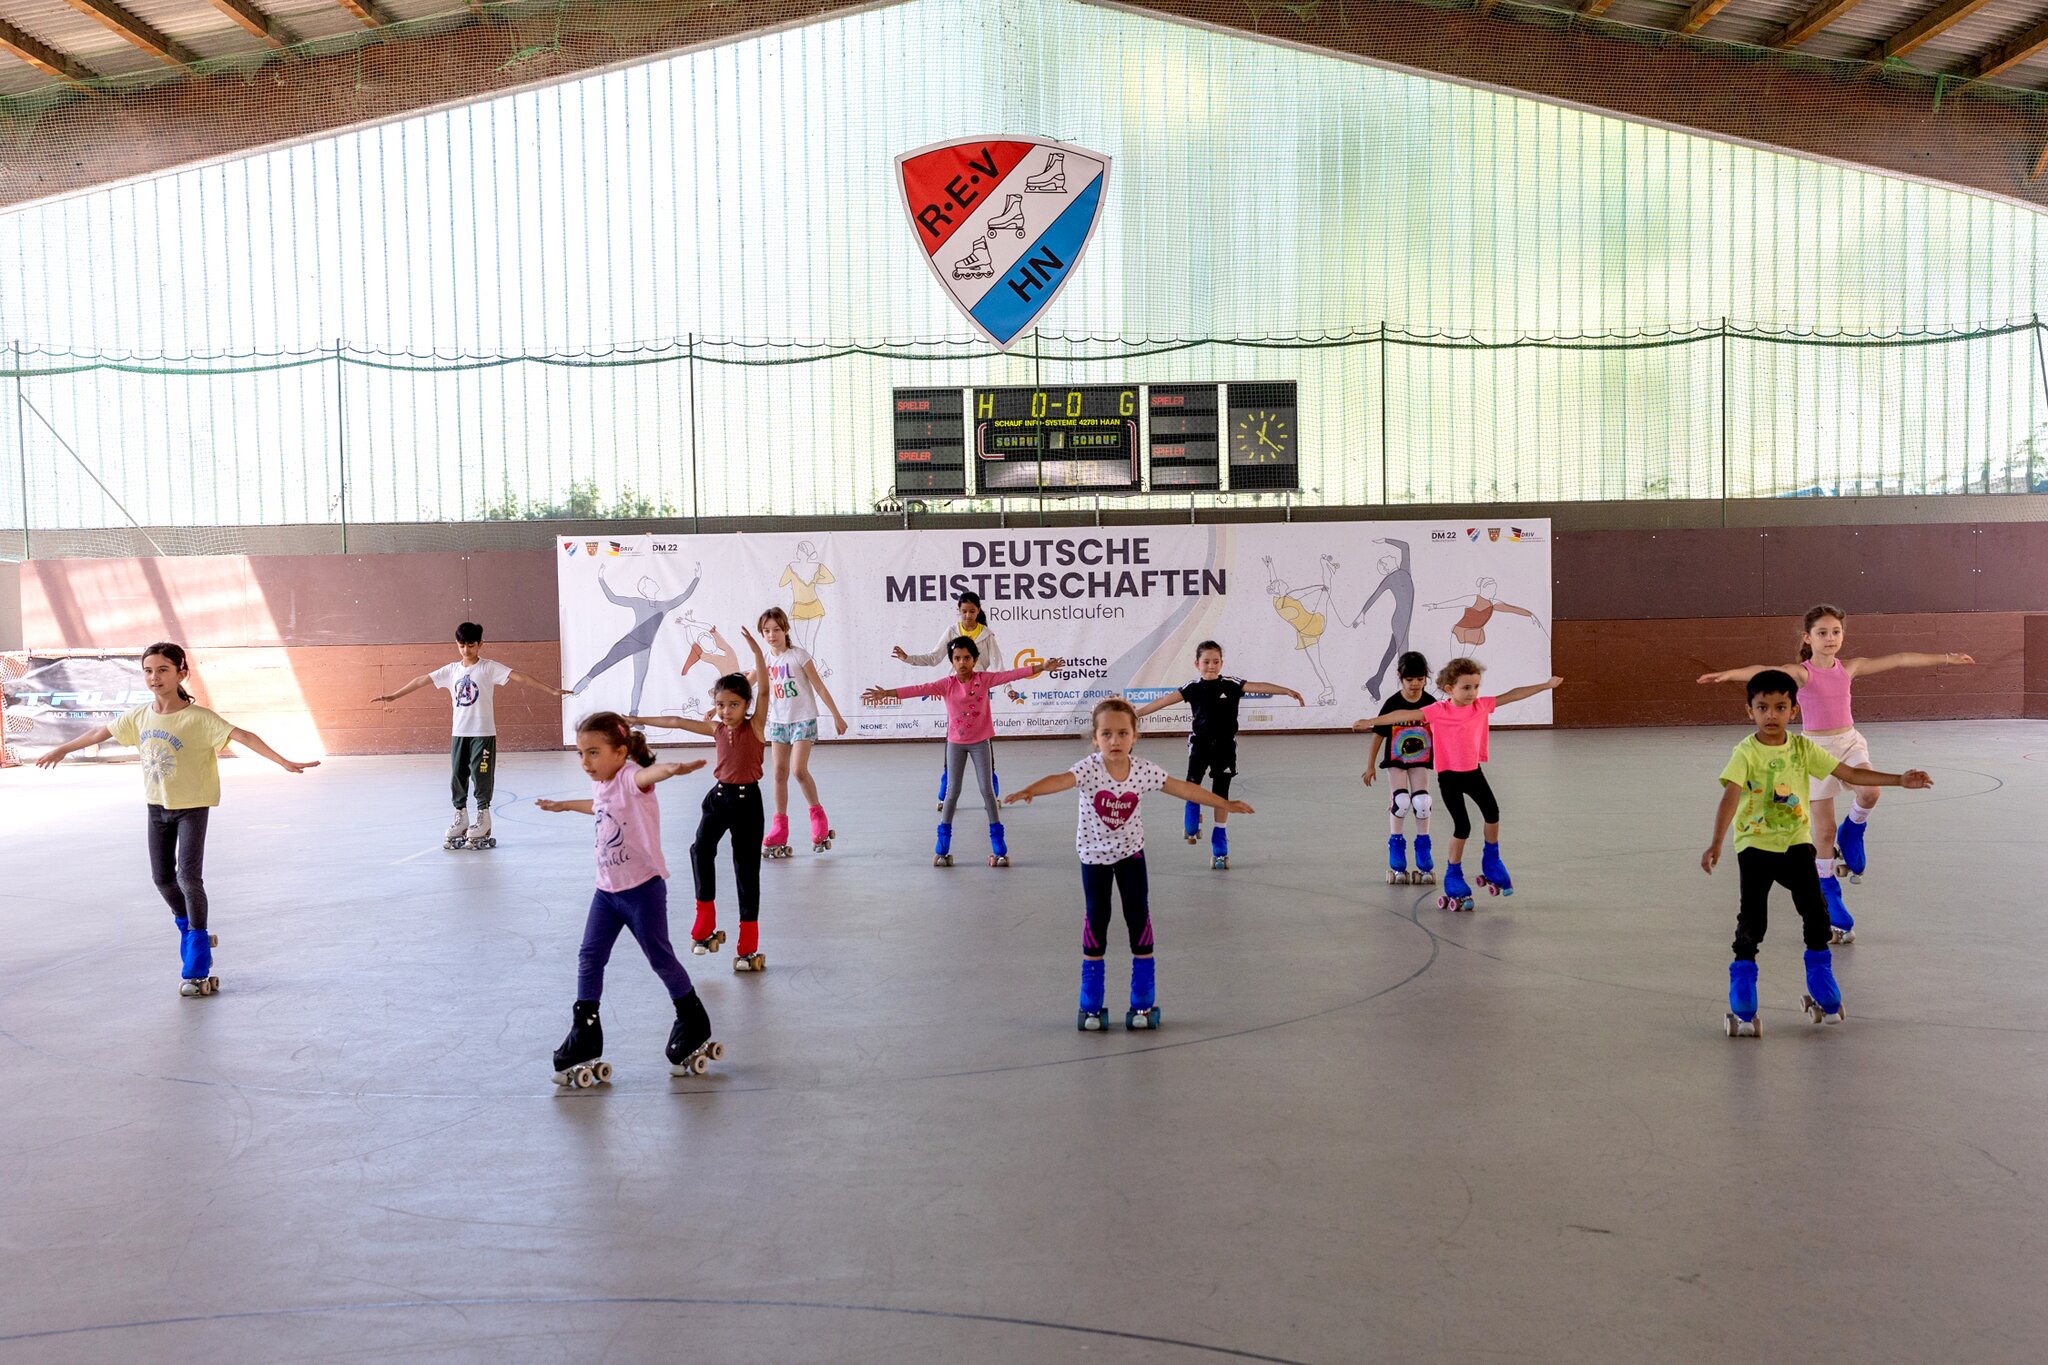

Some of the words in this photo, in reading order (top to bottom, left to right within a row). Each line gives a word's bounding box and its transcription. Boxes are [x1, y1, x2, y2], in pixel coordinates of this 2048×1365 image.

[1007, 246, 1064, 303] HN
[897, 401, 930, 411] SPIELER
[978, 394, 994, 419] H
[1119, 391, 1134, 417] G
[1151, 396, 1184, 406] SPIELER
[898, 451, 932, 461] SPIELER
[1153, 446, 1185, 457] SPIELER
[1446, 531, 1457, 539] 22
[667, 543, 678, 551] 22
[962, 537, 1150, 568] DEUTSCHE
[885, 569, 1226, 603] MEISTERSCHAFTEN
[989, 604, 1125, 622] Rollkunstlaufen
[1049, 656, 1108, 667] eutsche
[1049, 668, 1108, 681] GigaNetz
[1031, 691, 1080, 700] TIMETOACT
[92, 711, 110, 719] PLAY
[1026, 717, 1070, 726] Rolltanzen
[1101, 798, 1105, 806] I
[1106, 799, 1132, 809] believe
[1111, 809, 1119, 817] in
[1101, 815, 1126, 827] magic
